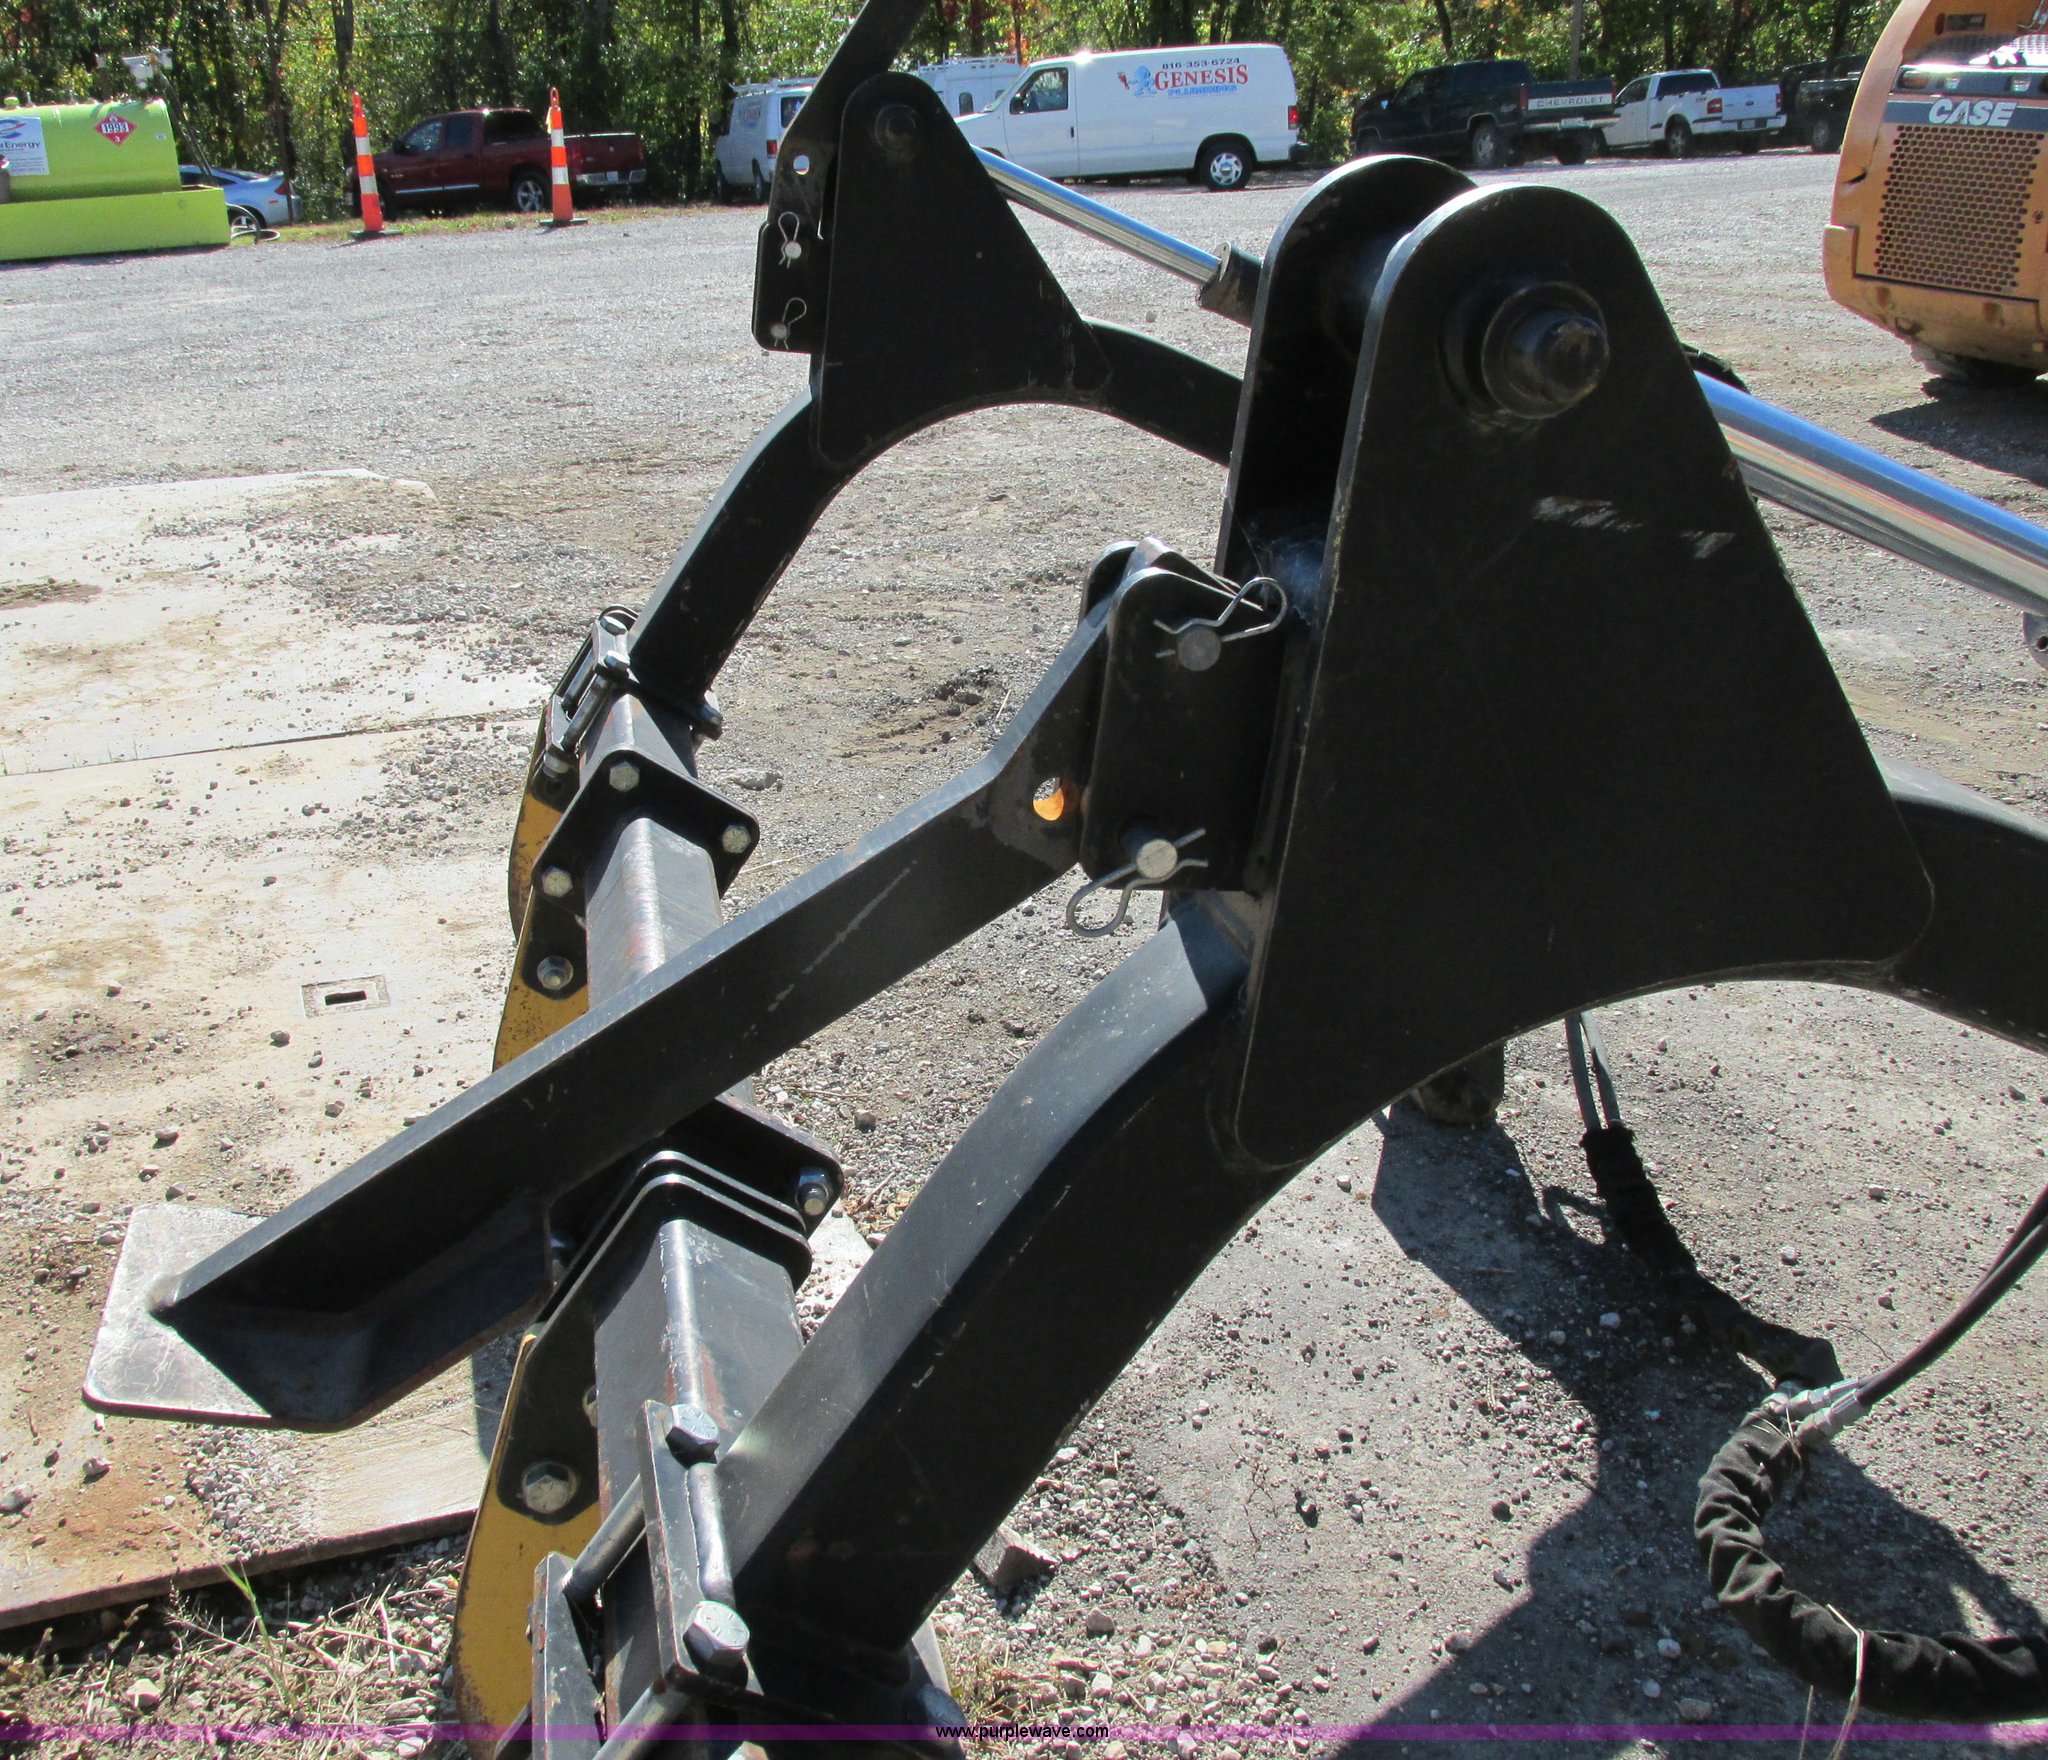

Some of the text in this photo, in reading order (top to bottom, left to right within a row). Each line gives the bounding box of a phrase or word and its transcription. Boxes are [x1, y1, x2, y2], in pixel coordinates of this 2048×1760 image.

[1162, 57, 1240, 70] 816-353-6724
[1154, 64, 1249, 91] GENESIS
[1536, 95, 1604, 108] CHEVROLET
[1928, 97, 2018, 128] CASE
[103, 123, 127, 133] 1993
